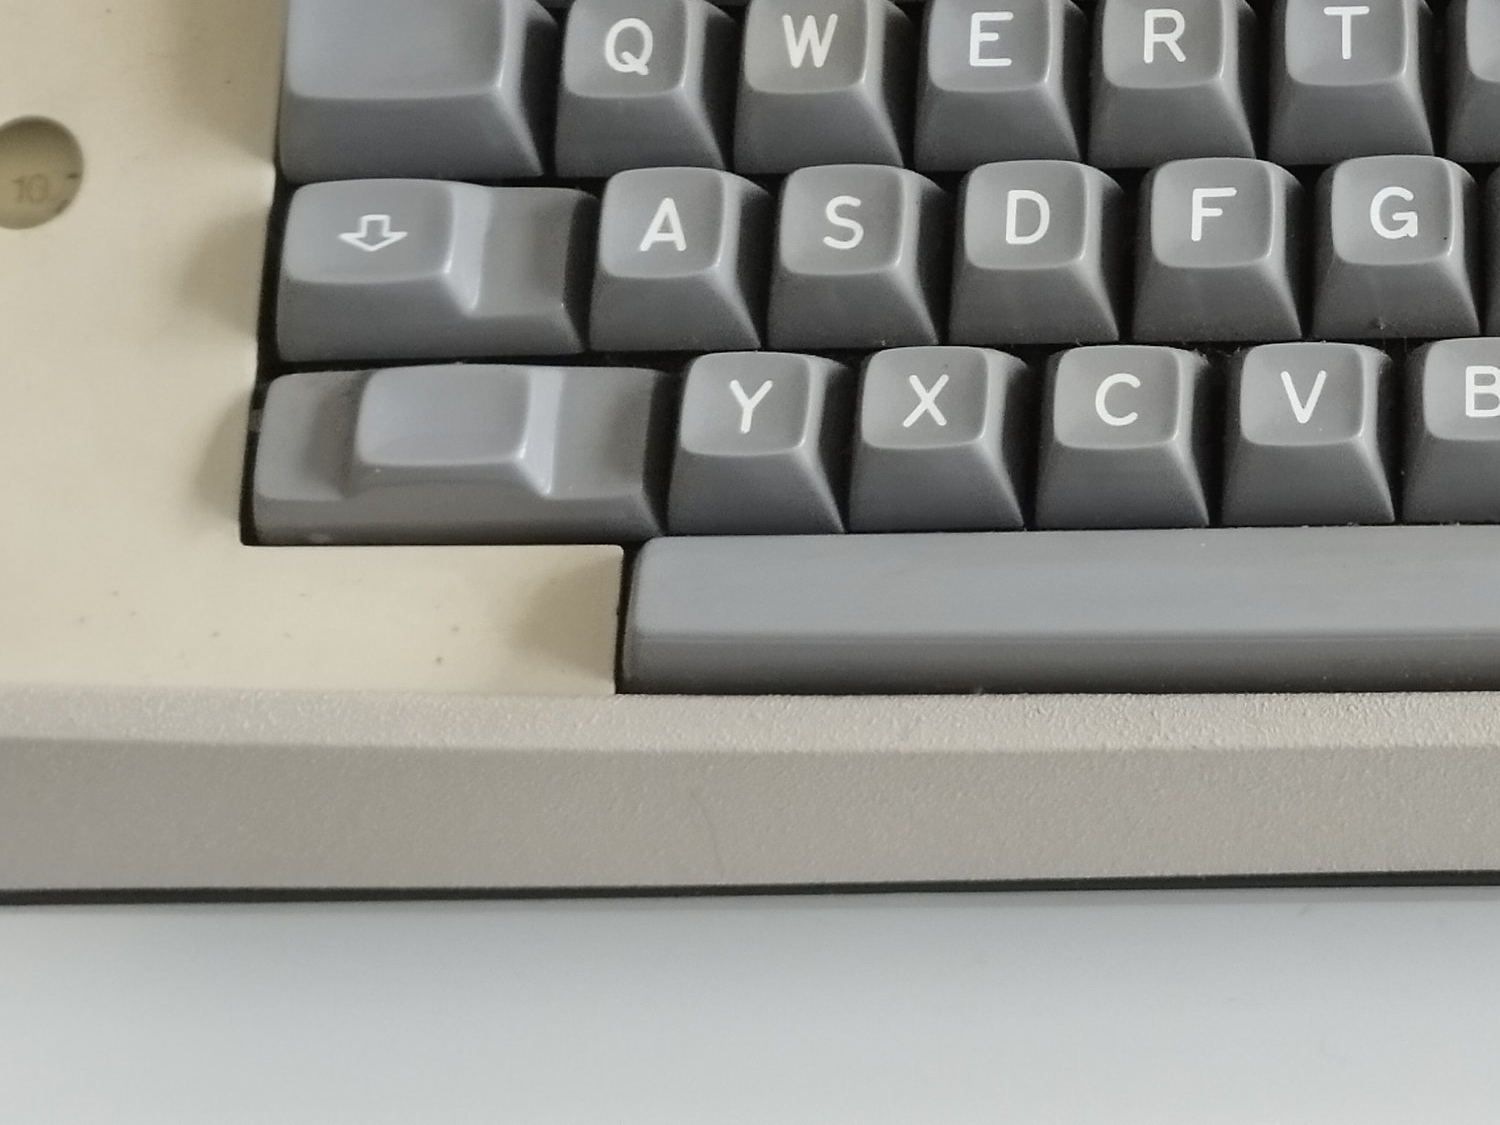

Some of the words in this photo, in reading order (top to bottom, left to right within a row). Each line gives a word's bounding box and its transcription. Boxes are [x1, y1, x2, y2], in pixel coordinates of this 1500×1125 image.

[603, 17, 654, 76] Q
[781, 13, 839, 69] W
[968, 11, 1015, 68] E
[1143, 8, 1187, 64] R
[1323, 5, 1371, 60] T
[638, 197, 687, 252] A
[822, 195, 865, 250] S
[1005, 189, 1051, 245] D
[1189, 186, 1232, 243] F
[1369, 185, 1419, 240] G
[729, 379, 774, 434] Y
[902, 373, 950, 428] X
[1094, 372, 1141, 427] C
[1280, 369, 1328, 424] V
